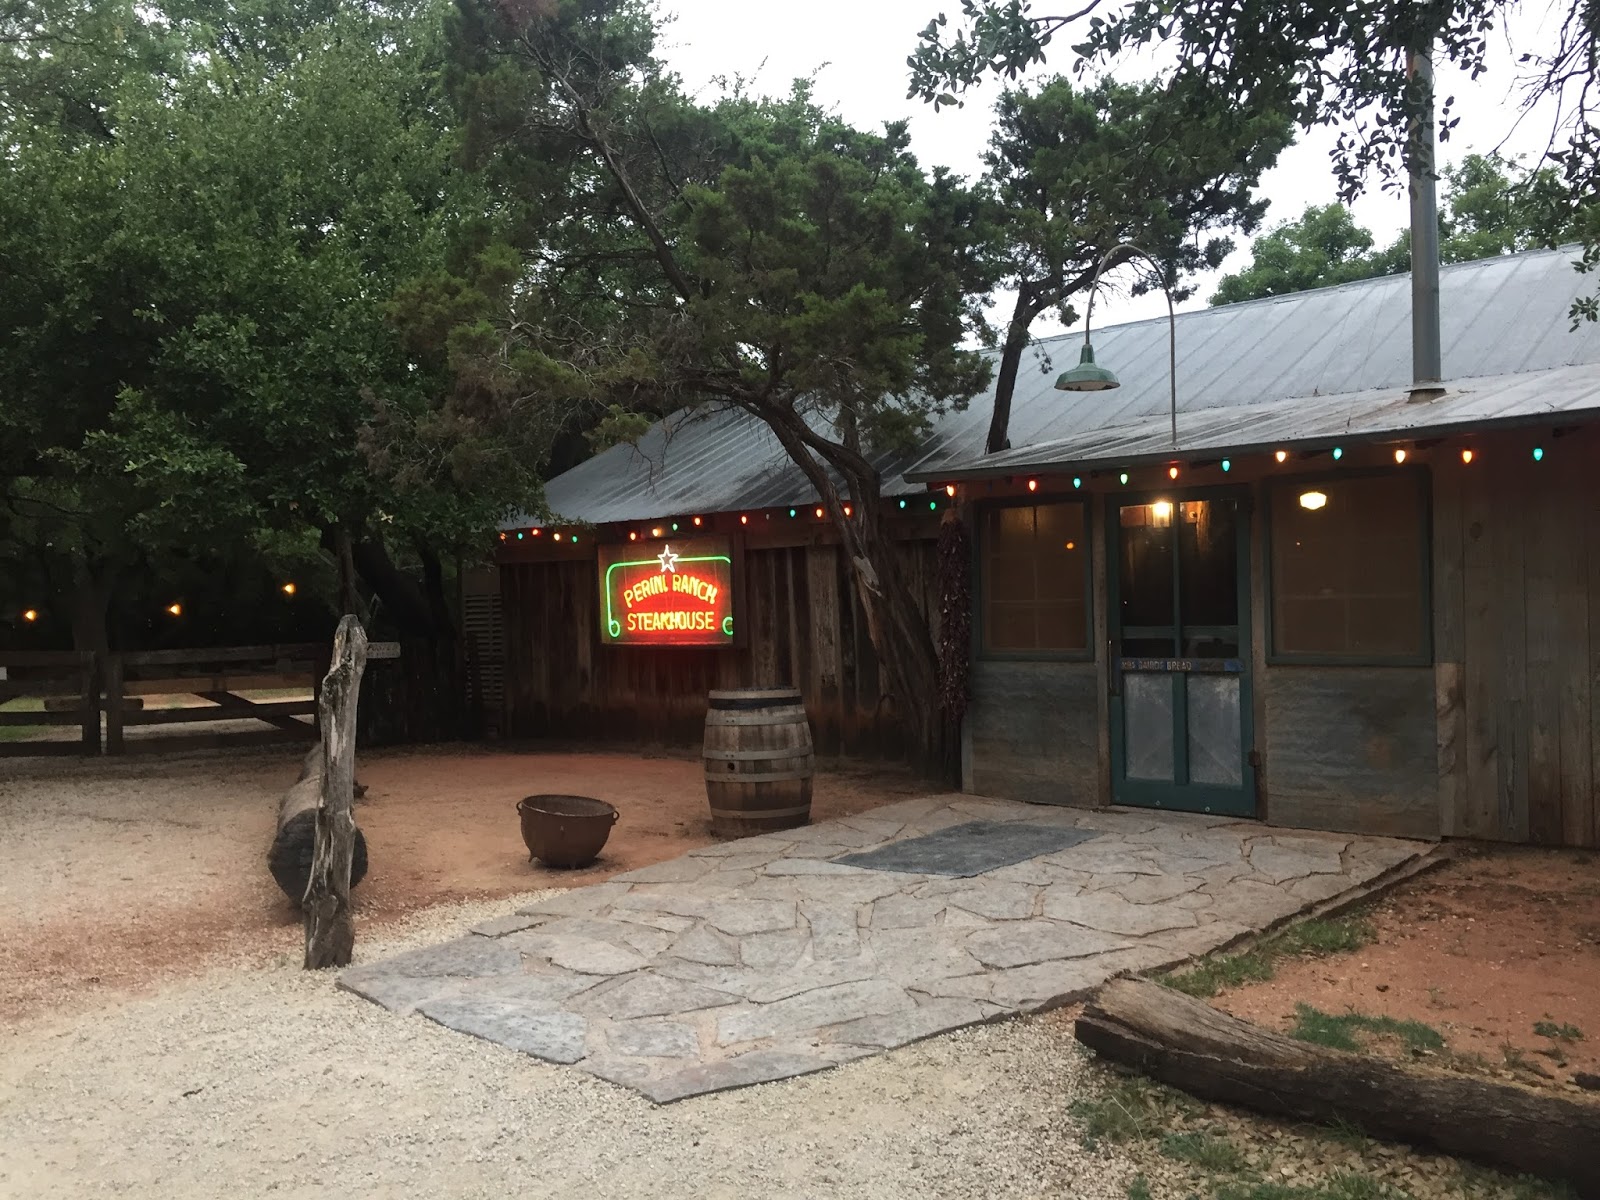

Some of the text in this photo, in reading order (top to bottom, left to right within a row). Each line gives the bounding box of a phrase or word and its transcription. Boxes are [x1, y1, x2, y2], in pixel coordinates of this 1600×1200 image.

[623, 574, 718, 608] PERINI RANCH
[627, 611, 715, 631] STEAKHOUSE
[1166, 661, 1191, 671] BREAD
